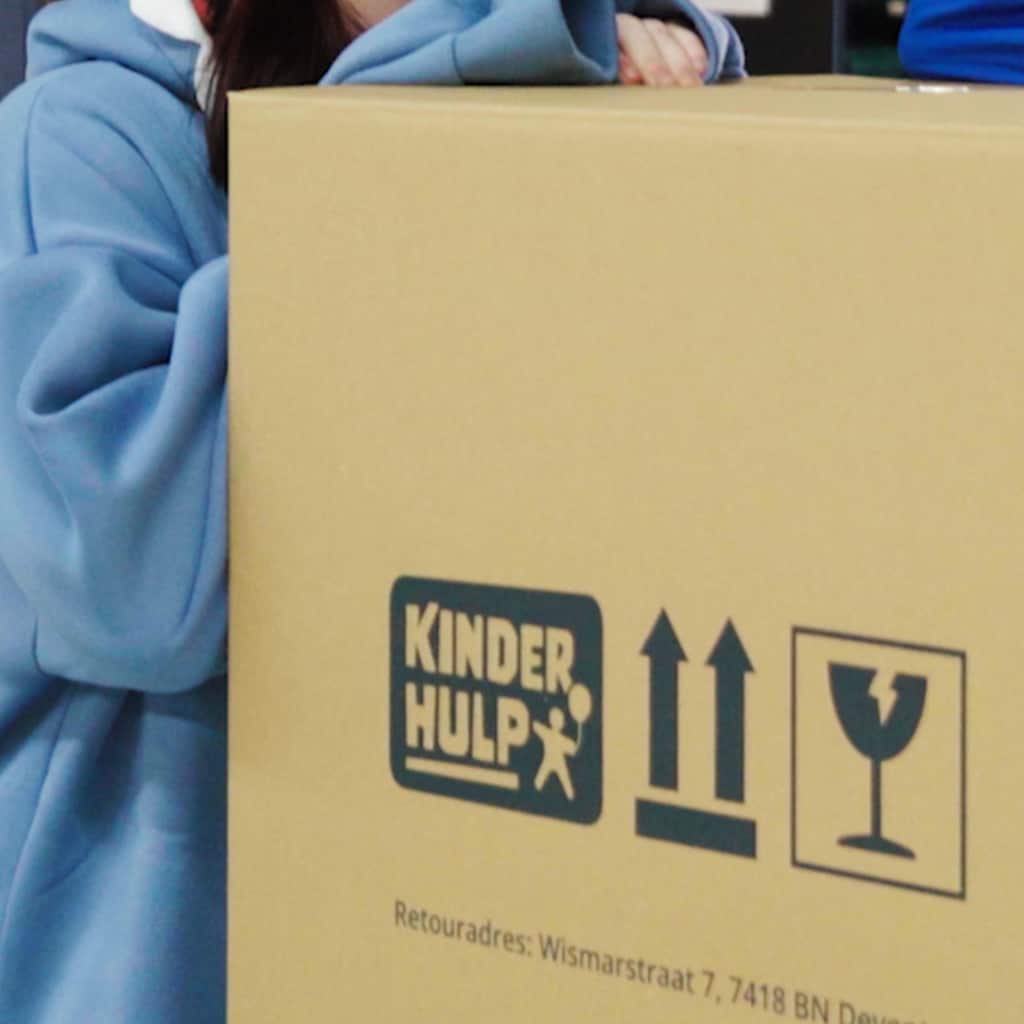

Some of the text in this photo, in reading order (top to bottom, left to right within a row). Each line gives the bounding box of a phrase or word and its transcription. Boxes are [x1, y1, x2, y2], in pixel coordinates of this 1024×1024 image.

[405, 601, 575, 694] KINDER
[405, 681, 530, 765] HULP
[394, 899, 532, 957] Retouradres:
[538, 931, 695, 994] Wismarstraat
[700, 970, 721, 1006] 7,
[728, 976, 787, 1016] 7418
[794, 991, 830, 1024] BN
